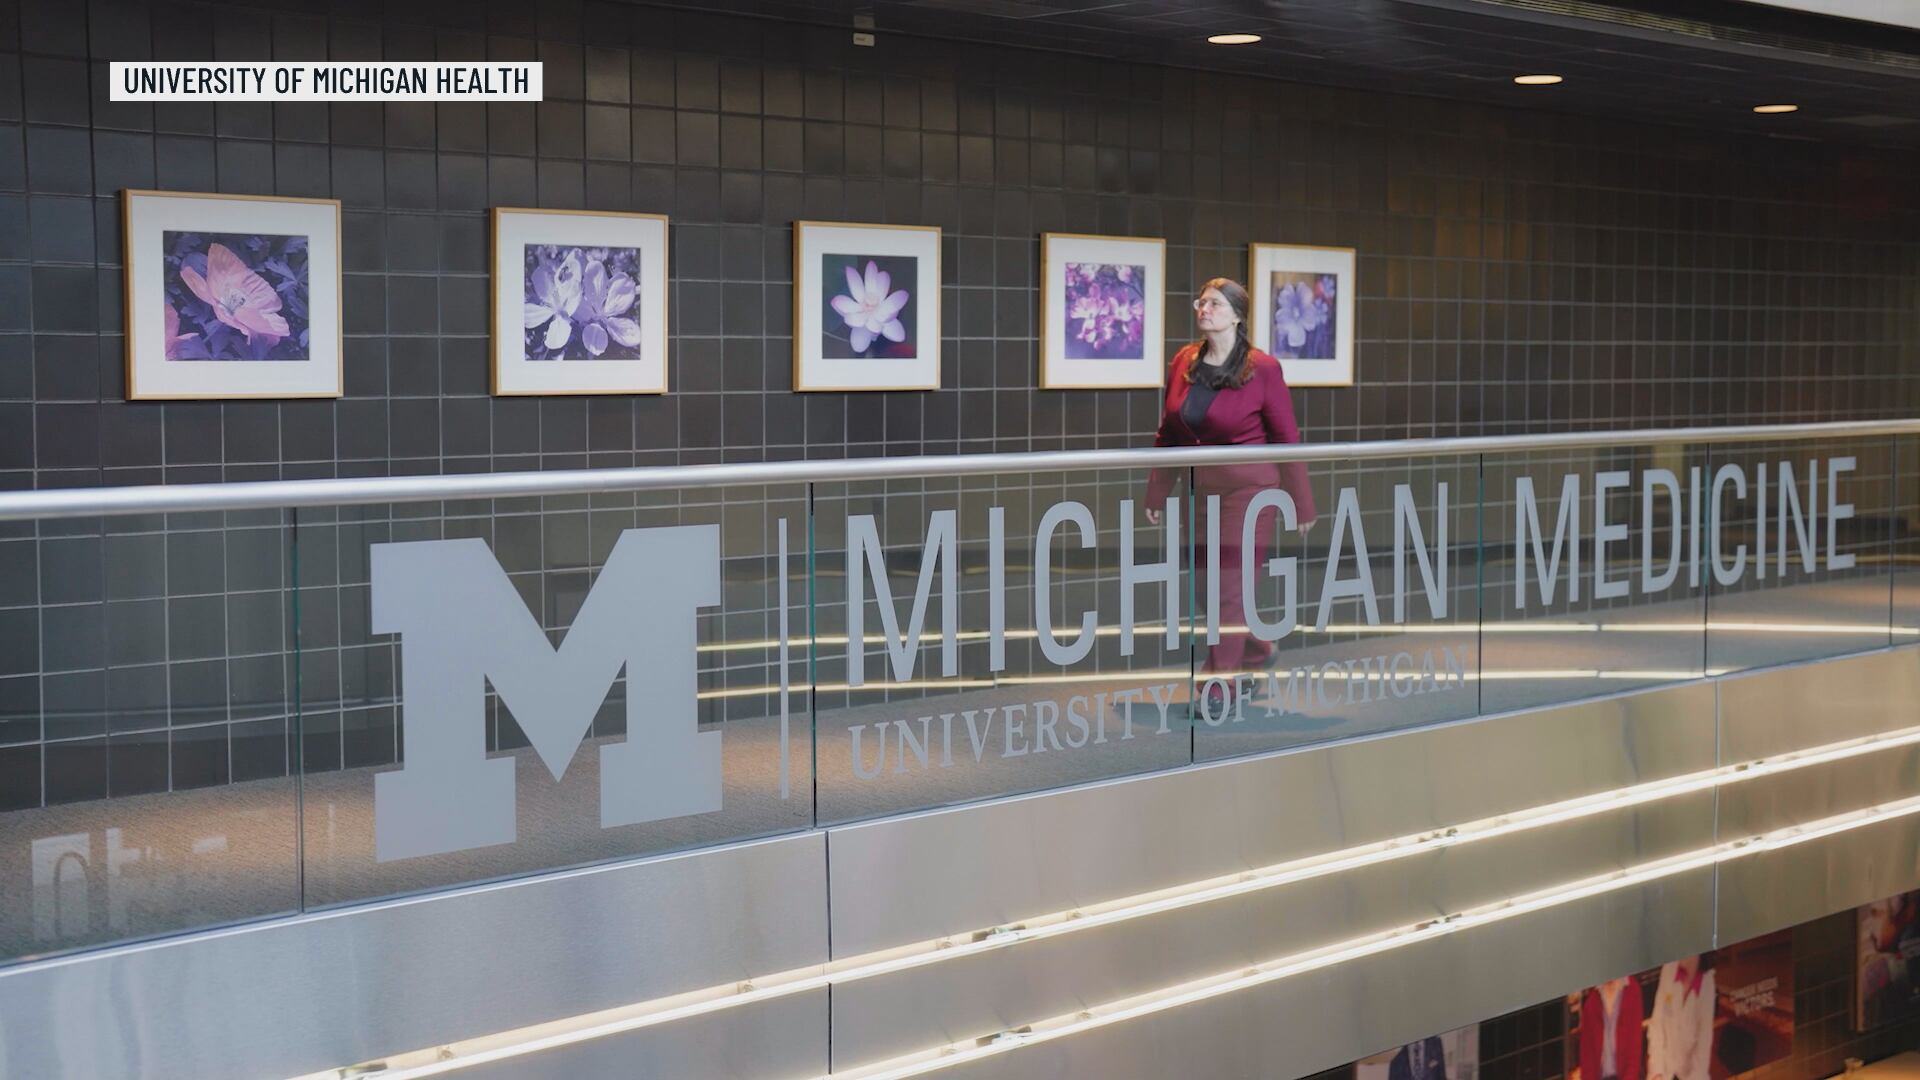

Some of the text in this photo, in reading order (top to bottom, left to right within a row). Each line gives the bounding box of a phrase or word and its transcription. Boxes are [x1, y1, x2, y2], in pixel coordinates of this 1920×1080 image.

[847, 456, 1857, 688] MICHIGAN MEDICINE
[370, 523, 723, 864] M
[847, 645, 1468, 781] UNIVERSITY OF MICHIGAN
